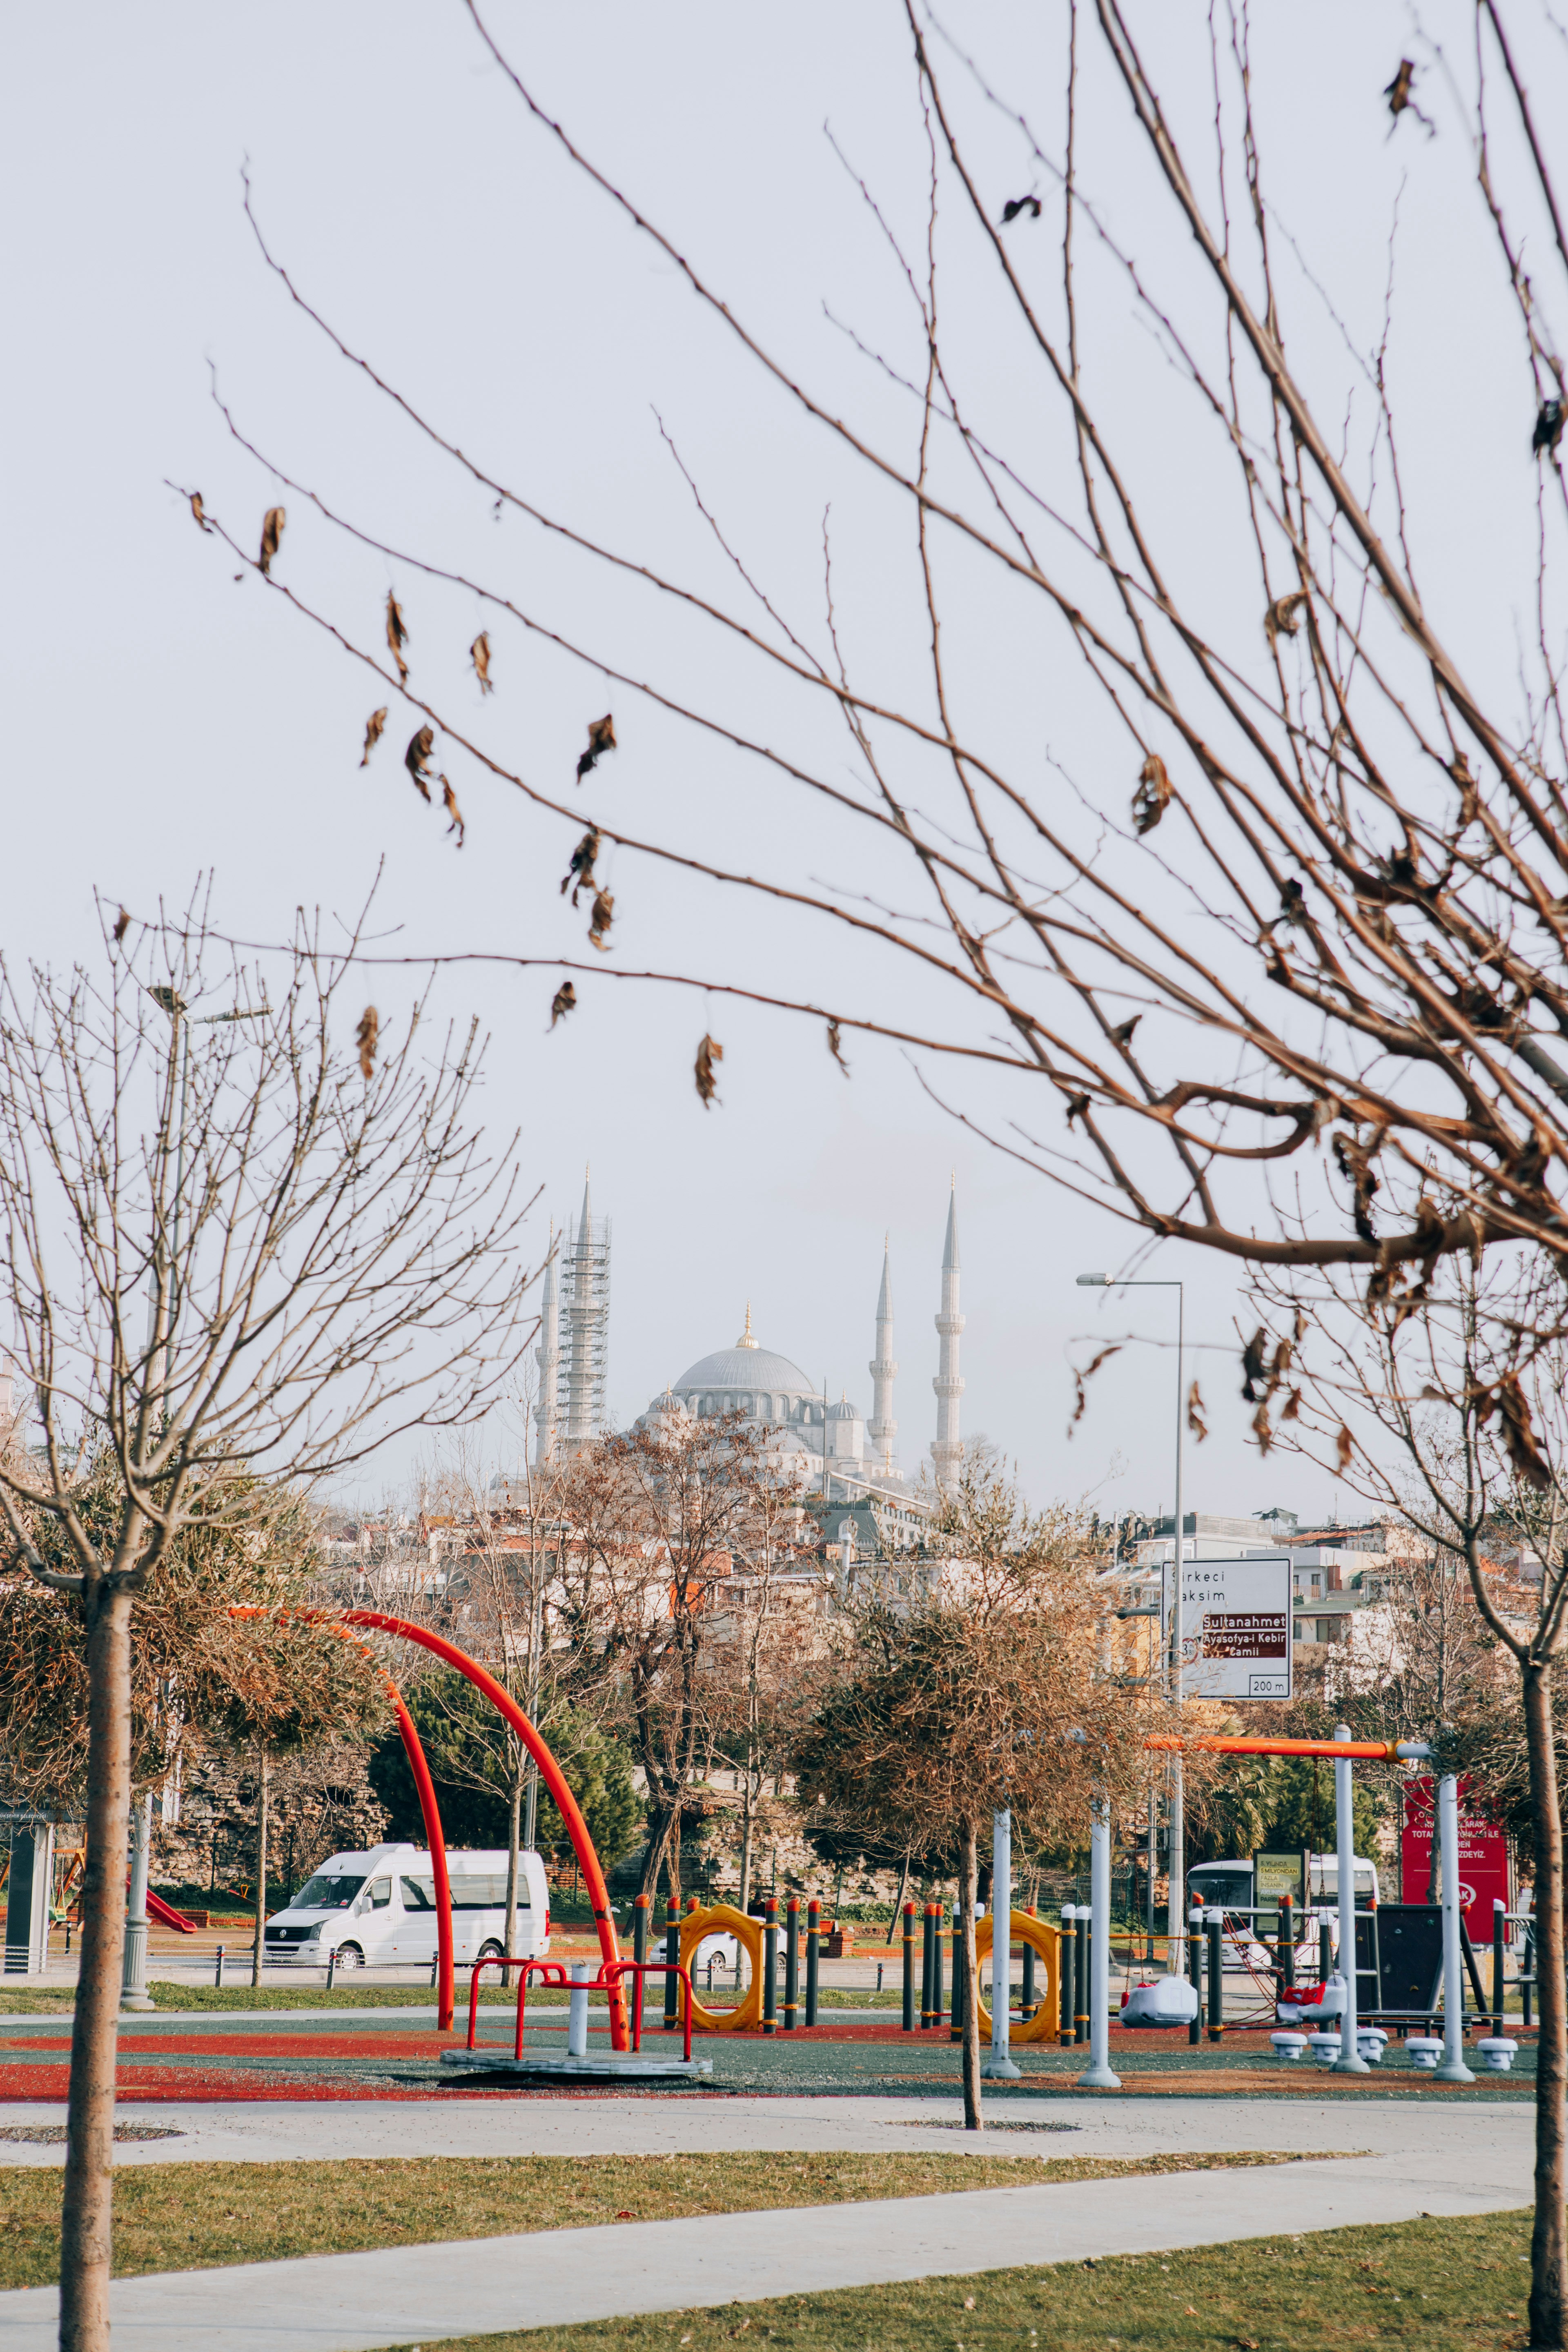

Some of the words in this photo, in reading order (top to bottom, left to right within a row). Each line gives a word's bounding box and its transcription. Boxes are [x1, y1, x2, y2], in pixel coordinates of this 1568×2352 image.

[1182, 1590, 1225, 1601] aksim
[1203, 1616, 1286, 1628] Sultanahmet
[1203, 1633, 1255, 1646] Ayasofya-i
[1258, 1633, 1286, 1643] Kebir
[1229, 1646, 1259, 1657] Camii
[1254, 1681, 1272, 1691] 200
[1458, 1820, 1485, 1828] LARAK
